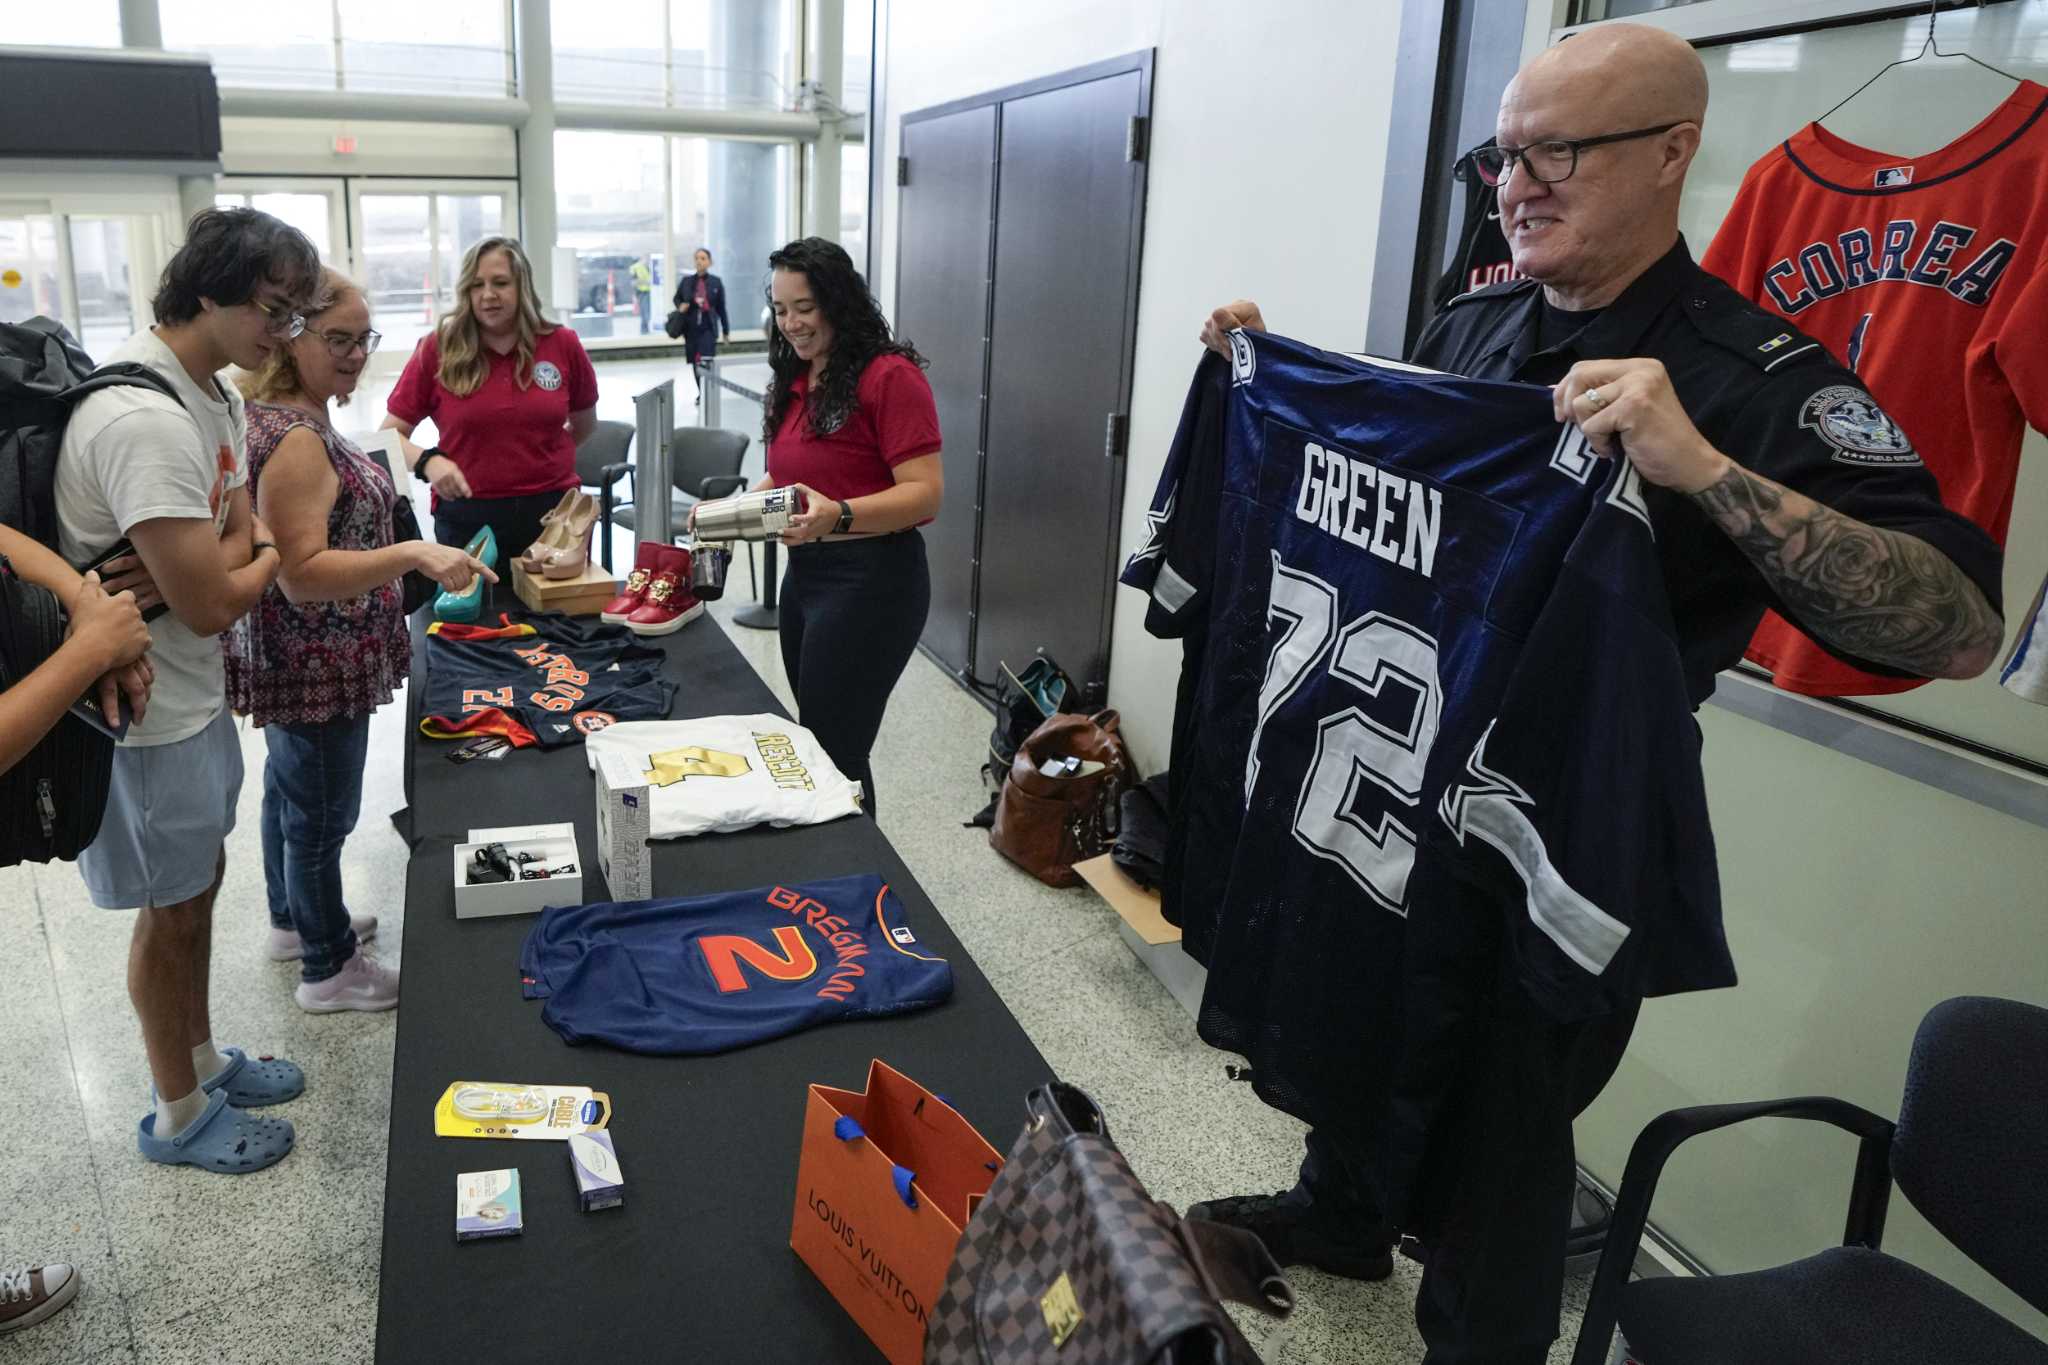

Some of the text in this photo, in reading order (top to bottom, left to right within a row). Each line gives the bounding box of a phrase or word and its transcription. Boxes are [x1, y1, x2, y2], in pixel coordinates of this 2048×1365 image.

[1764, 219, 2019, 309] CORREA
[1295, 441, 1443, 579] GREEN
[1244, 548, 1444, 920] 72
[698, 925, 818, 995] 2
[808, 1188, 855, 1248] LOUIS
